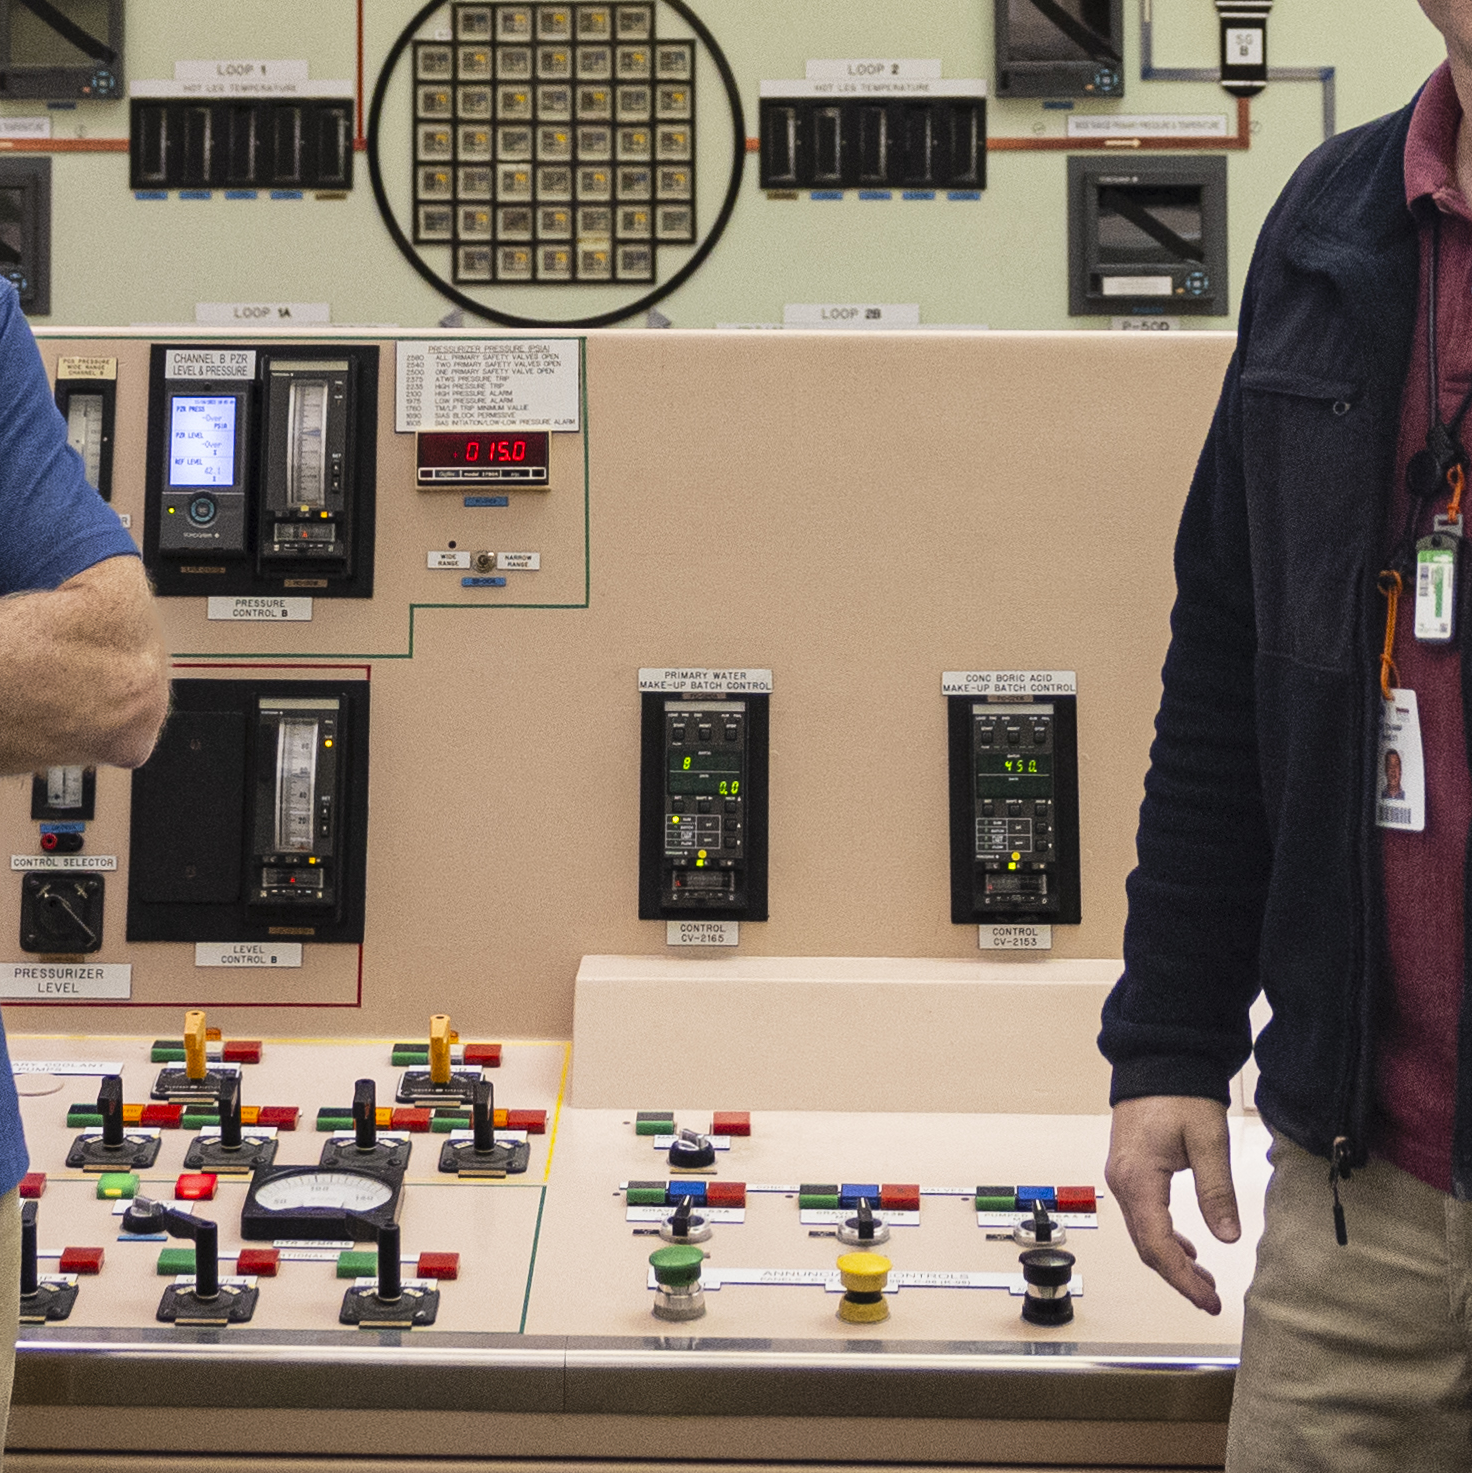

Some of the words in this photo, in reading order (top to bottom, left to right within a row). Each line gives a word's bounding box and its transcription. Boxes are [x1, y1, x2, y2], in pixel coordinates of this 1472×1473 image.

[1240, 45, 1249, 56] B
[217, 65, 254, 76] LOOP
[848, 64, 884, 75] LOOP
[891, 63, 900, 75] 2
[174, 354, 215, 364] CHANNEL
[220, 354, 225, 364] B
[230, 355, 248, 364] PZR
[174, 366, 197, 376] LEVEL
[199, 366, 203, 376] &
[206, 366, 247, 376] PRESSURE
[235, 599, 285, 608] PRESSURE
[232, 609, 276, 618] CONTROL
[282, 609, 288, 617] B
[665, 672, 709, 680] PRIMARY
[713, 672, 746, 680] WATER
[966, 674, 993, 683] CONC
[997, 674, 1026, 683] BORIC
[1030, 674, 1053, 683] ACID
[640, 681, 687, 690] MAKE-UP
[690, 681, 724, 691] BATCH
[728, 682, 772, 691] CONTROL
[943, 684, 991, 693] MAKE-UP
[995, 684, 1028, 693] BATCH
[1031, 684, 1075, 694] CONTROL
[14, 859, 60, 867] CONTROL
[63, 859, 114, 867] SELECTOR
[680, 925, 726, 933] CONTROL
[992, 928, 1038, 936] CONTROL
[681, 934, 724, 943] CV-2165
[993, 938, 1037, 946] CV-2153
[221, 956, 267, 964] CONTROL
[14, 968, 104, 979] PRESSURIZER
[38, 983, 79, 994] LEVEL
